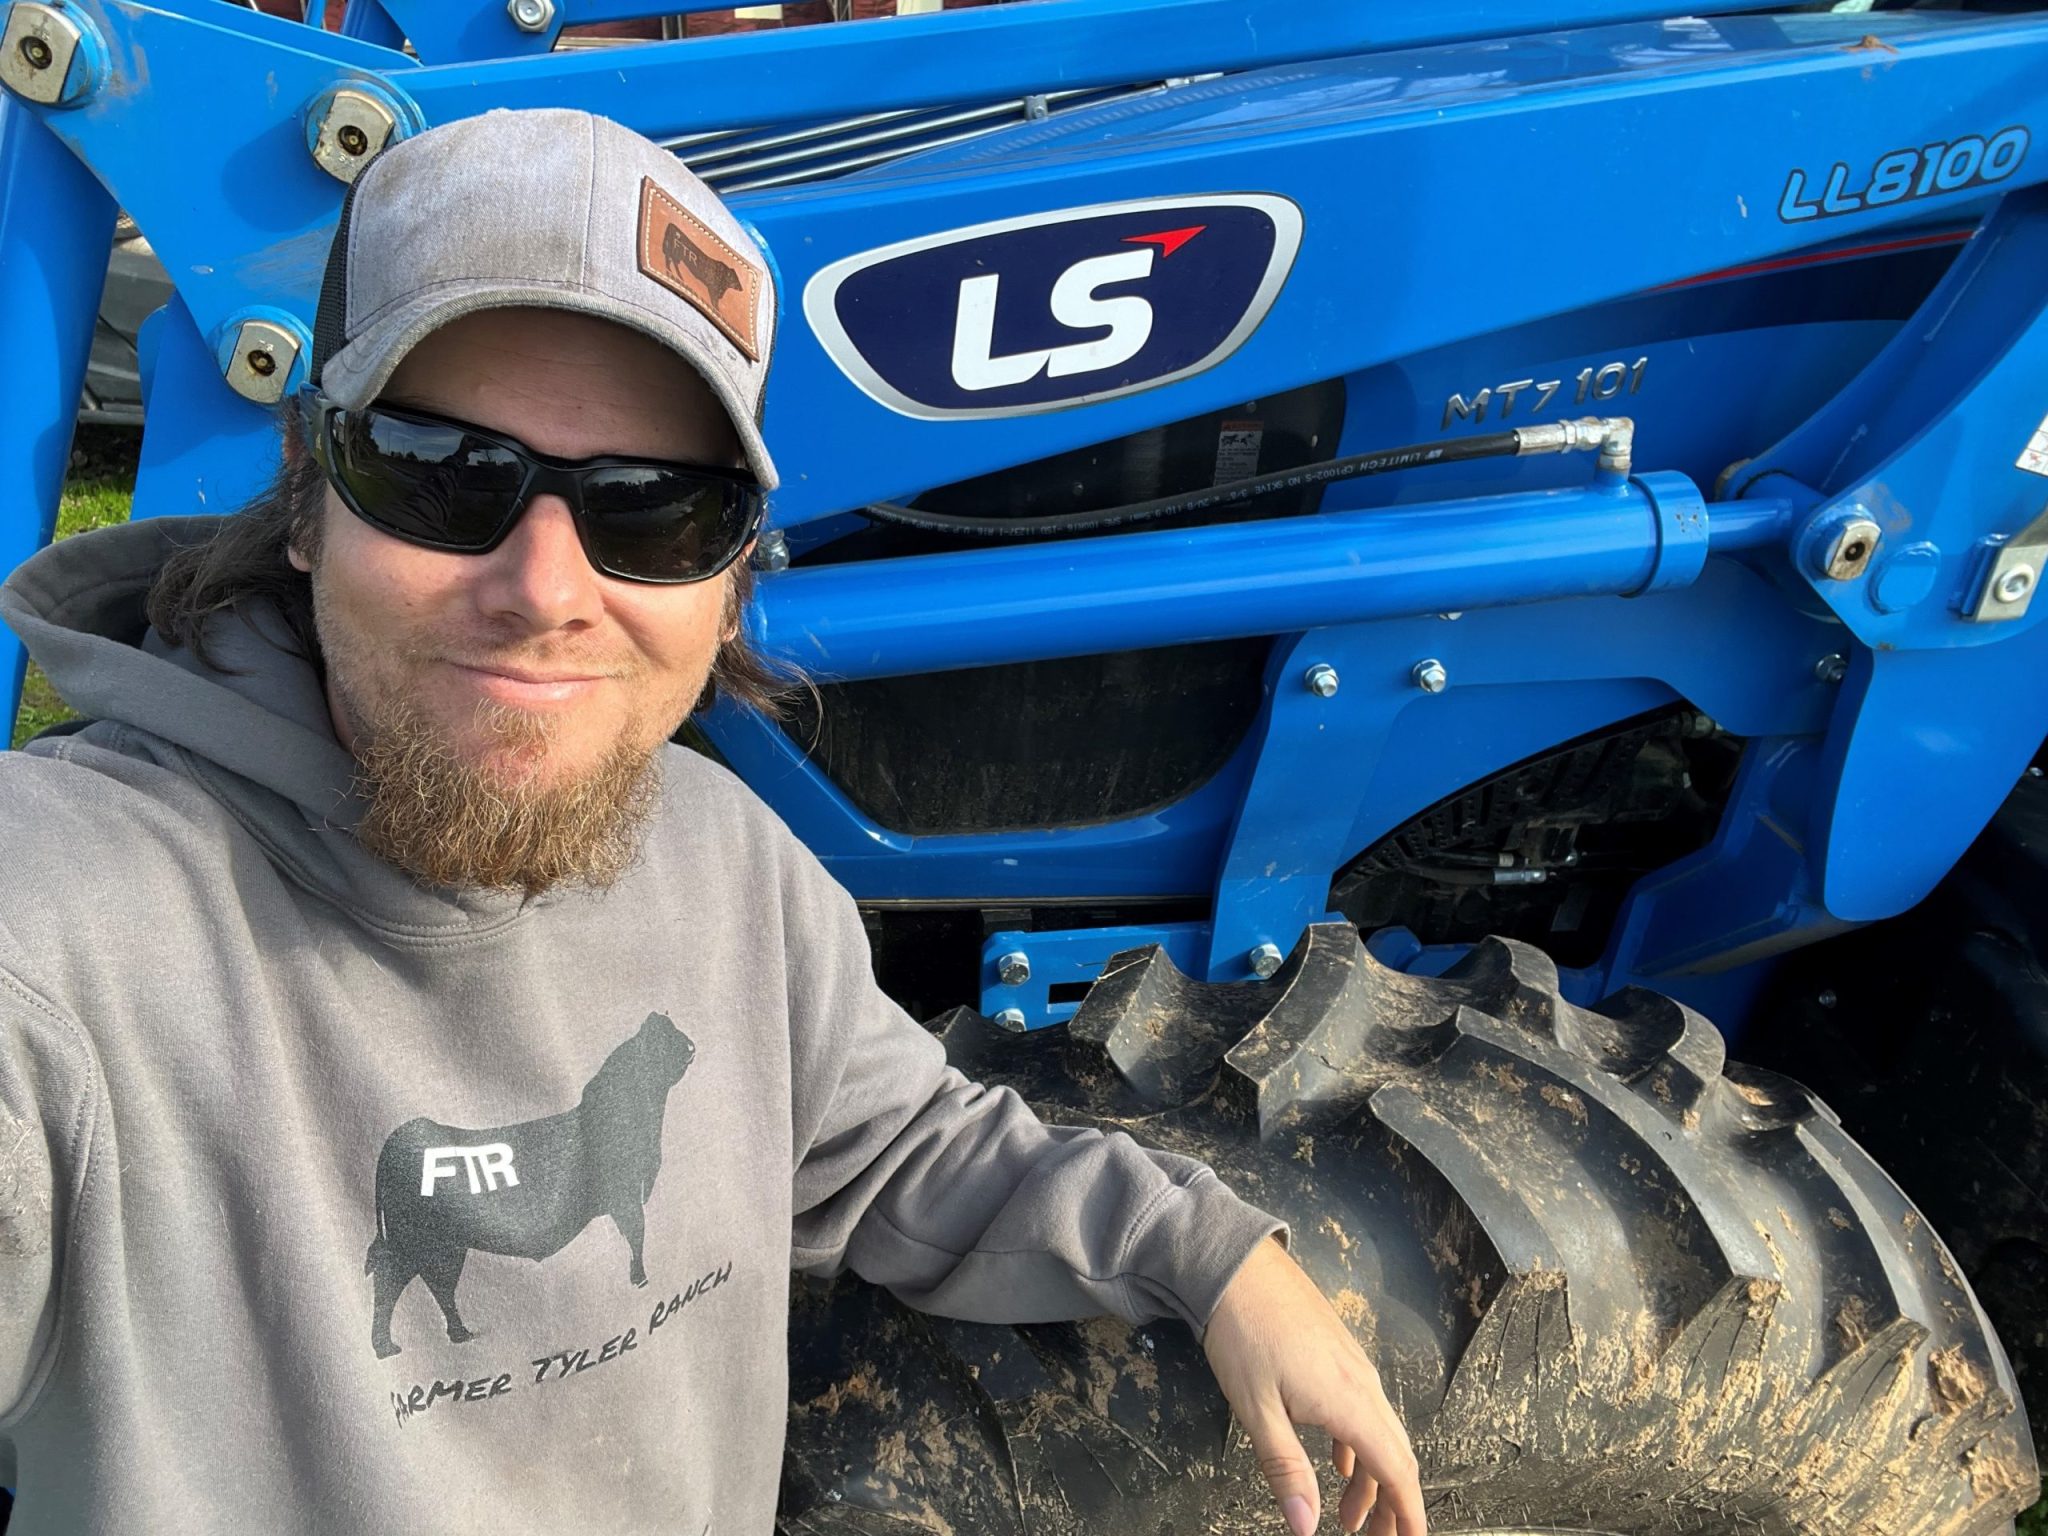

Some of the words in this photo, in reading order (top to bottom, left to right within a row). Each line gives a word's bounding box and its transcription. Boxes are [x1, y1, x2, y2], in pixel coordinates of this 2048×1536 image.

[1777, 125, 2031, 224] LL8100
[674, 238, 698, 269] FTR
[951, 248, 1154, 391] LS
[1441, 378, 1561, 431] MT7
[1574, 356, 1648, 405] 101
[1359, 451, 1421, 472] LIMITECH
[420, 1142, 520, 1197] FTR
[531, 1327, 638, 1384] TYLER
[649, 1260, 733, 1336] RANCH
